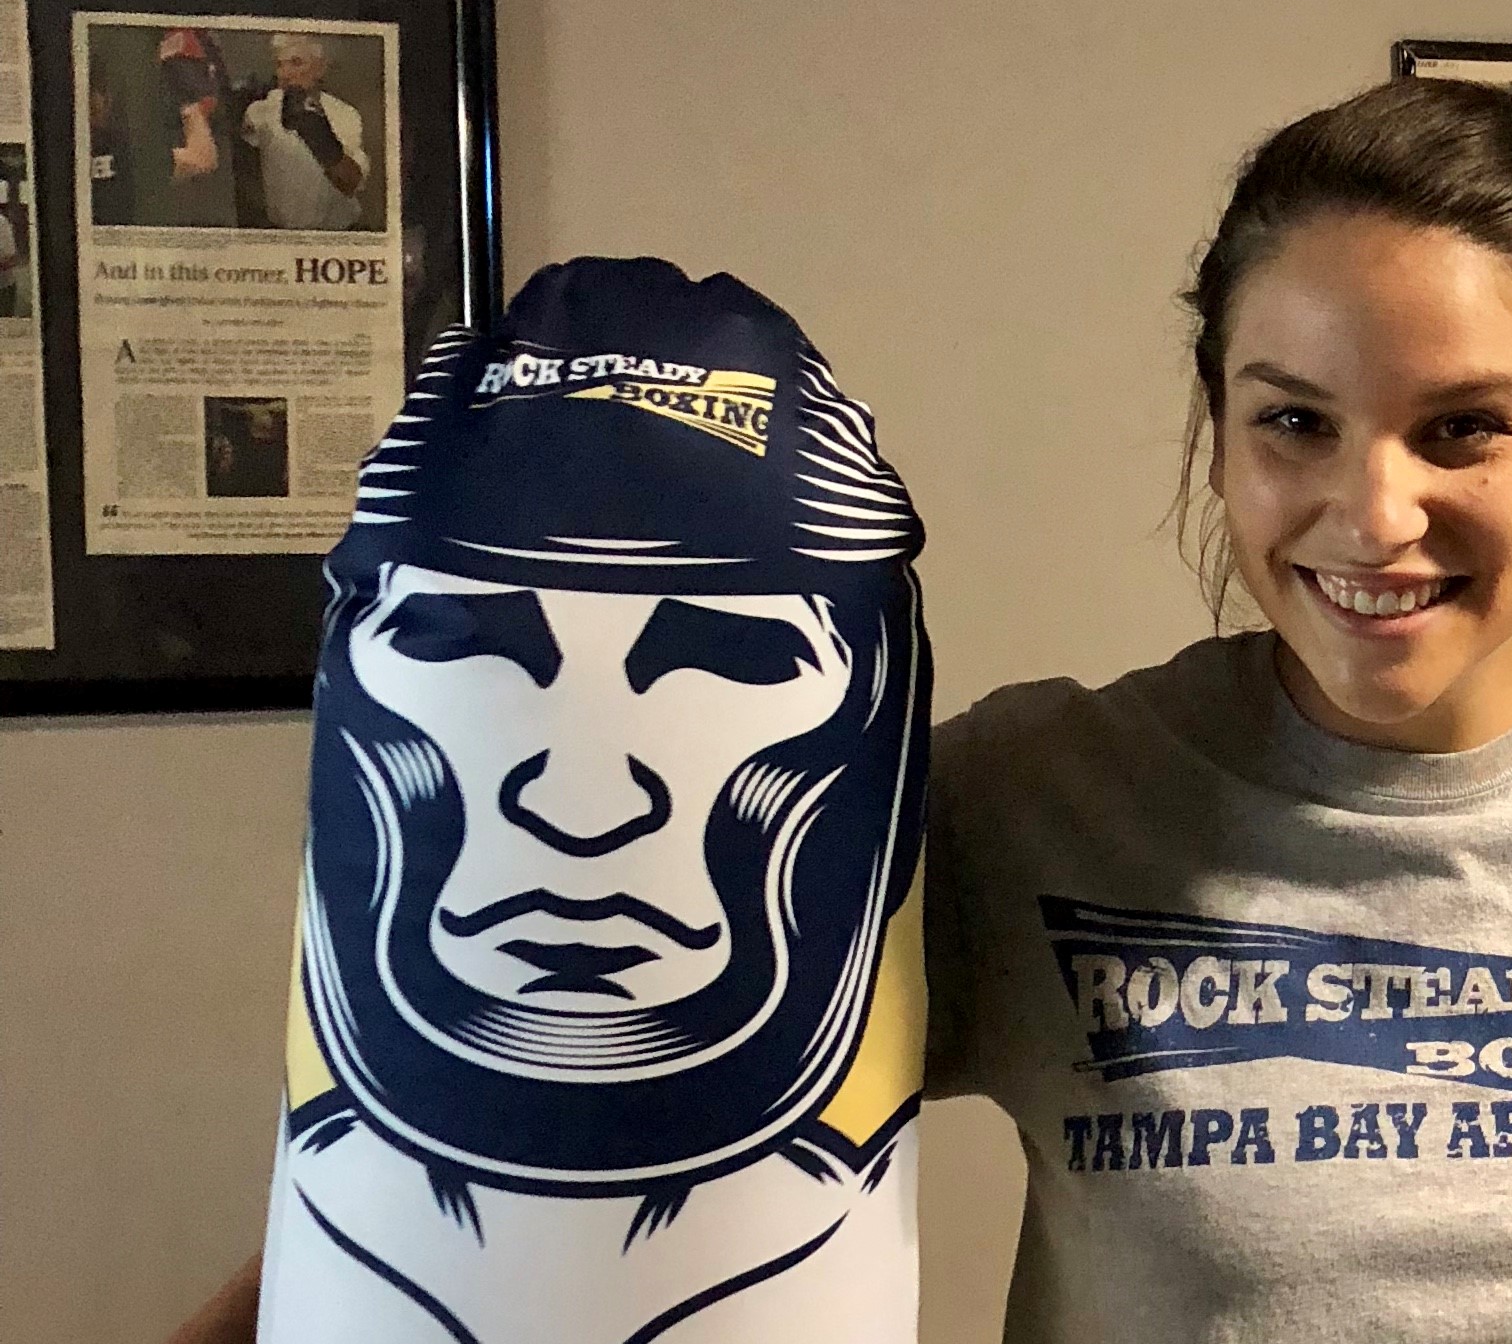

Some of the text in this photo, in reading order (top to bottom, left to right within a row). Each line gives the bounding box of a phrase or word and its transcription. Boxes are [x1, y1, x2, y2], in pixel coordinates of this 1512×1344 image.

[93, 261, 136, 281] And
[144, 263, 164, 280] in
[170, 261, 209, 281] this
[295, 258, 388, 285] HOPE
[568, 353, 709, 385] STEADY
[1070, 954, 1290, 1030] ROCK
[1063, 1103, 1276, 1172] TAMPA
[1295, 1102, 1428, 1161] BAY
